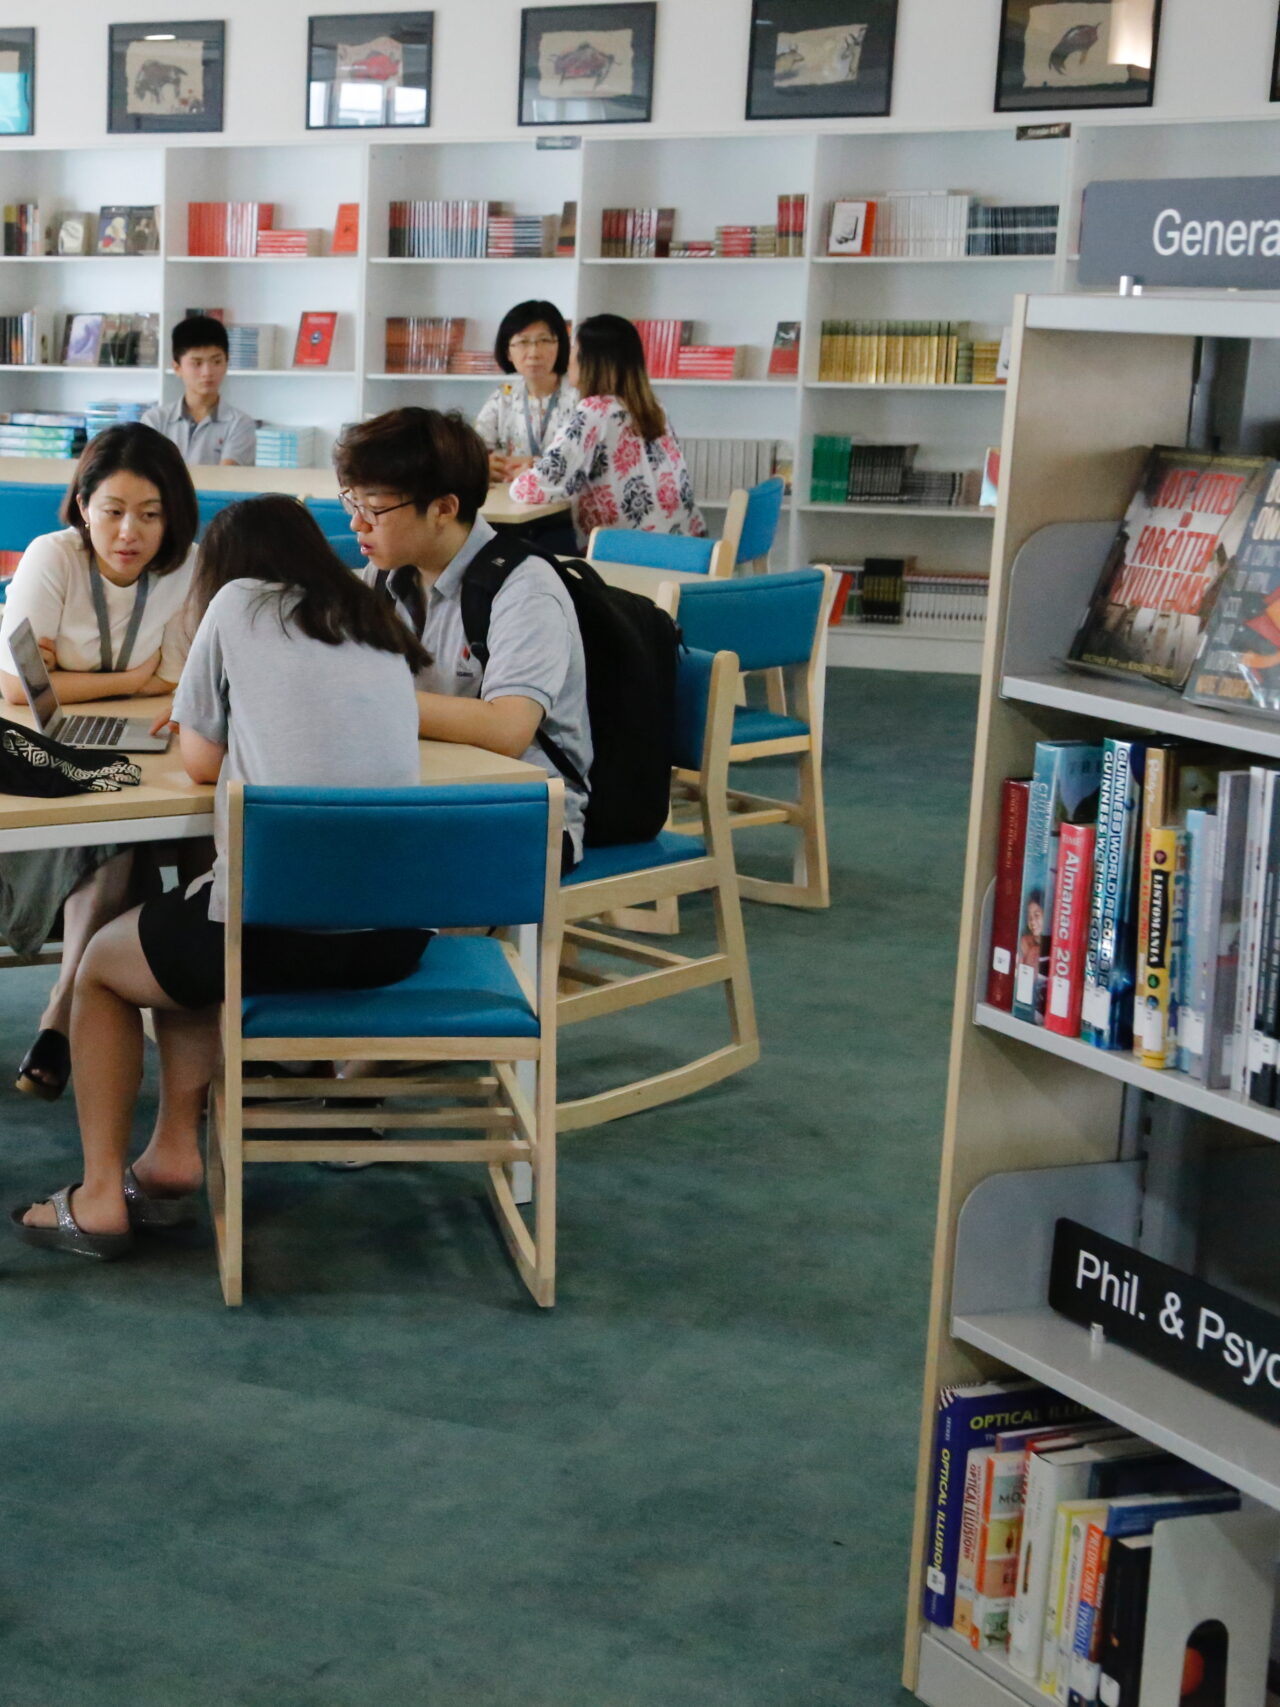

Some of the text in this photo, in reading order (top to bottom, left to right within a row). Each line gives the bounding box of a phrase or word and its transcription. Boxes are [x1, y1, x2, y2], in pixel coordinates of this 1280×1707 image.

[1152, 208, 1280, 256] Genera
[1153, 469, 1198, 510] LOST
[1191, 472, 1246, 515] CITIES
[1131, 525, 1221, 573] FORGOTTEN
[1097, 750, 1114, 834] GUINNESS
[1111, 747, 1129, 832] GUINNESS
[1093, 837, 1107, 892] WORLD
[1106, 836, 1121, 893] WORLD
[1058, 850, 1081, 941] Almanac
[1149, 873, 1164, 964] LISTOMANIA
[1086, 895, 1103, 970] RECORDS
[1099, 898, 1115, 971] RECORDS
[1055, 947, 1072, 978] 20
[1075, 1249, 1280, 1388] Phil. & Psyc
[969, 1409, 1040, 1431] OPTICAL
[932, 1447, 951, 1572] OPTICAL ILLUSION
[964, 1463, 978, 1505] OPTICAL
[963, 1506, 977, 1560] ILLUSIONS
[1081, 1527, 1102, 1605] PREDICTABLY
[1073, 1603, 1092, 1657] ATIONAL
